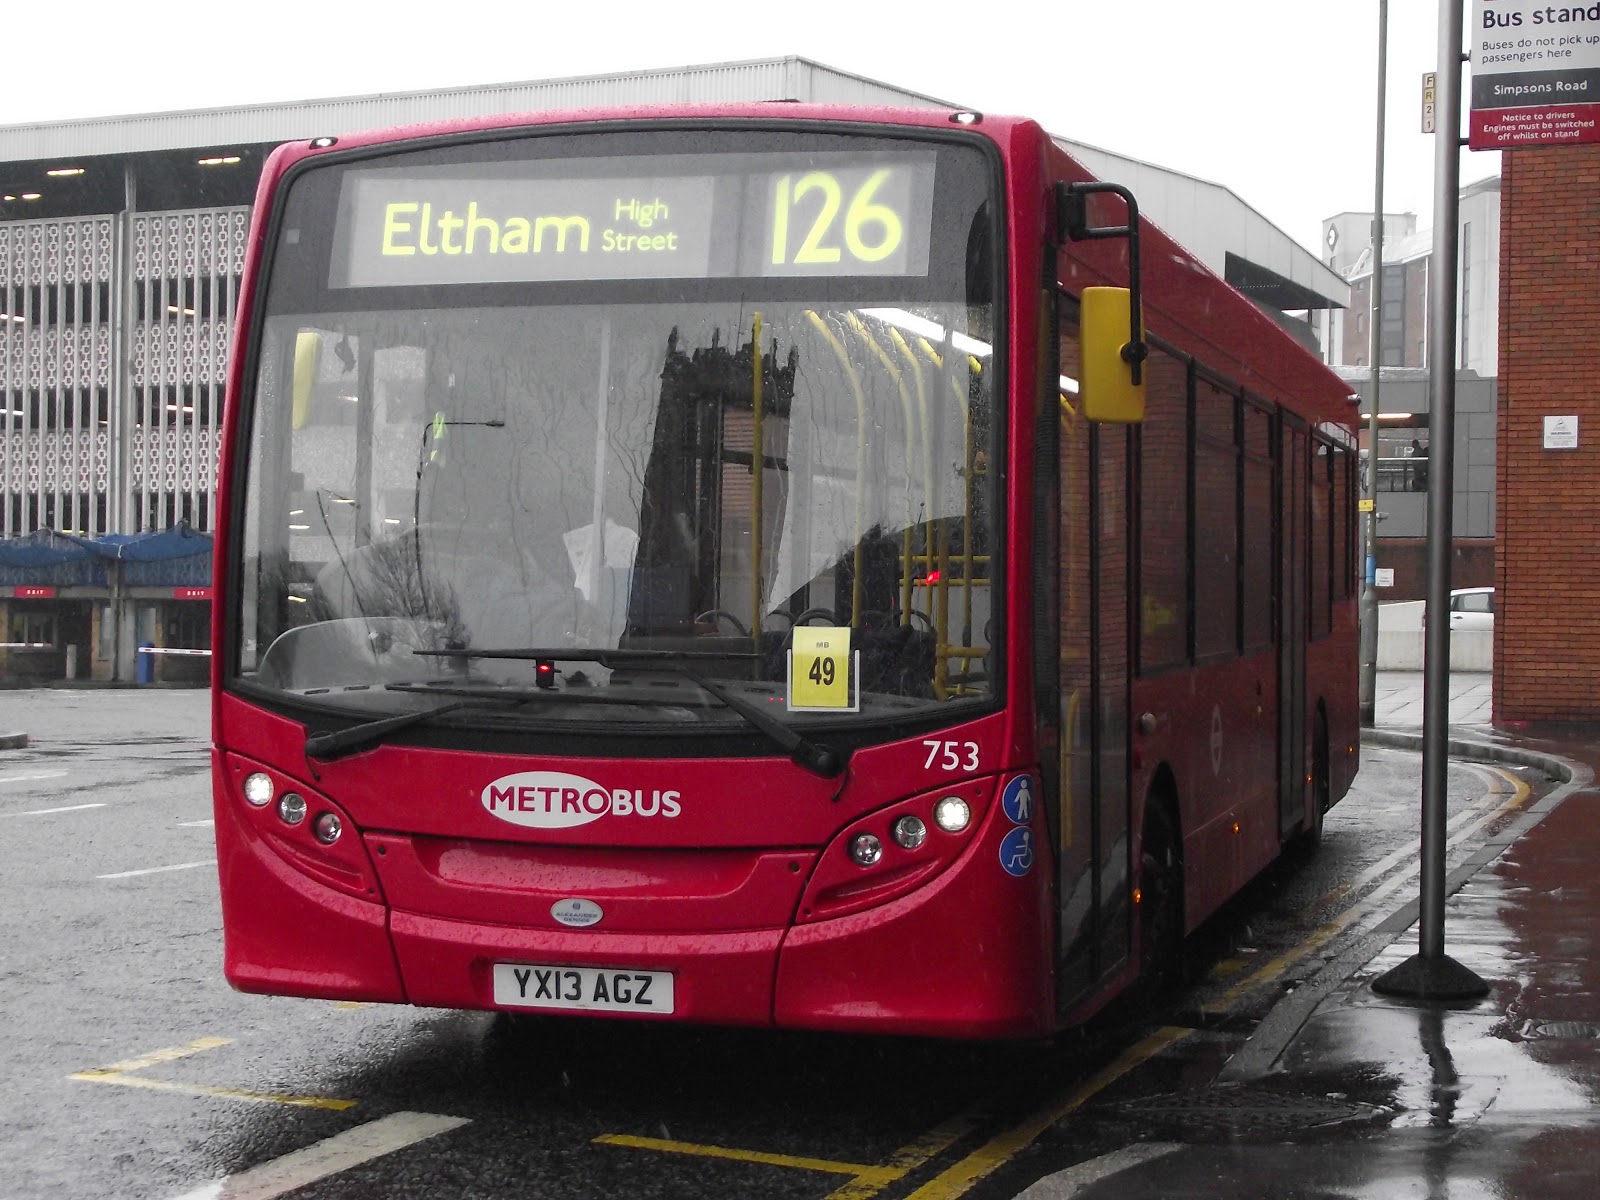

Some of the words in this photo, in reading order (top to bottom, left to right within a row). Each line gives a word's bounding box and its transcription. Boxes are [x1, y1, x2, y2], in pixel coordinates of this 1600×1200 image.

[1483, 10, 1523, 29] Bus
[1532, 2, 1600, 25] stand
[1482, 40, 1514, 51] Buses
[1517, 38, 1532, 48] do
[1536, 37, 1555, 46] not
[1559, 34, 1582, 47] pick
[1586, 35, 1600, 46] up
[1482, 51, 1543, 65] passengers
[1547, 49, 1572, 58] here
[1494, 83, 1552, 96] Simpsons
[1556, 79, 1588, 92] Road
[1483, 123, 1516, 133] Engines
[1518, 122, 1540, 131] must
[1542, 121, 1553, 129] be
[1555, 119, 1595, 128] switched
[1502, 113, 1532, 122] Notice
[1546, 111, 1576, 120] drivers
[1497, 133, 1511, 141] off
[1513, 131, 1539, 140] whilst
[1554, 129, 1580, 138] stand
[615, 197, 669, 228] High
[771, 167, 903, 265] 126
[382, 201, 590, 255] Eltham
[601, 228, 679, 252] Street
[816, 641, 830, 649] MB
[808, 656, 836, 686] 49
[923, 740, 979, 771] 753
[514, 968, 582, 1001] YX13
[593, 972, 653, 1005] AGZ
